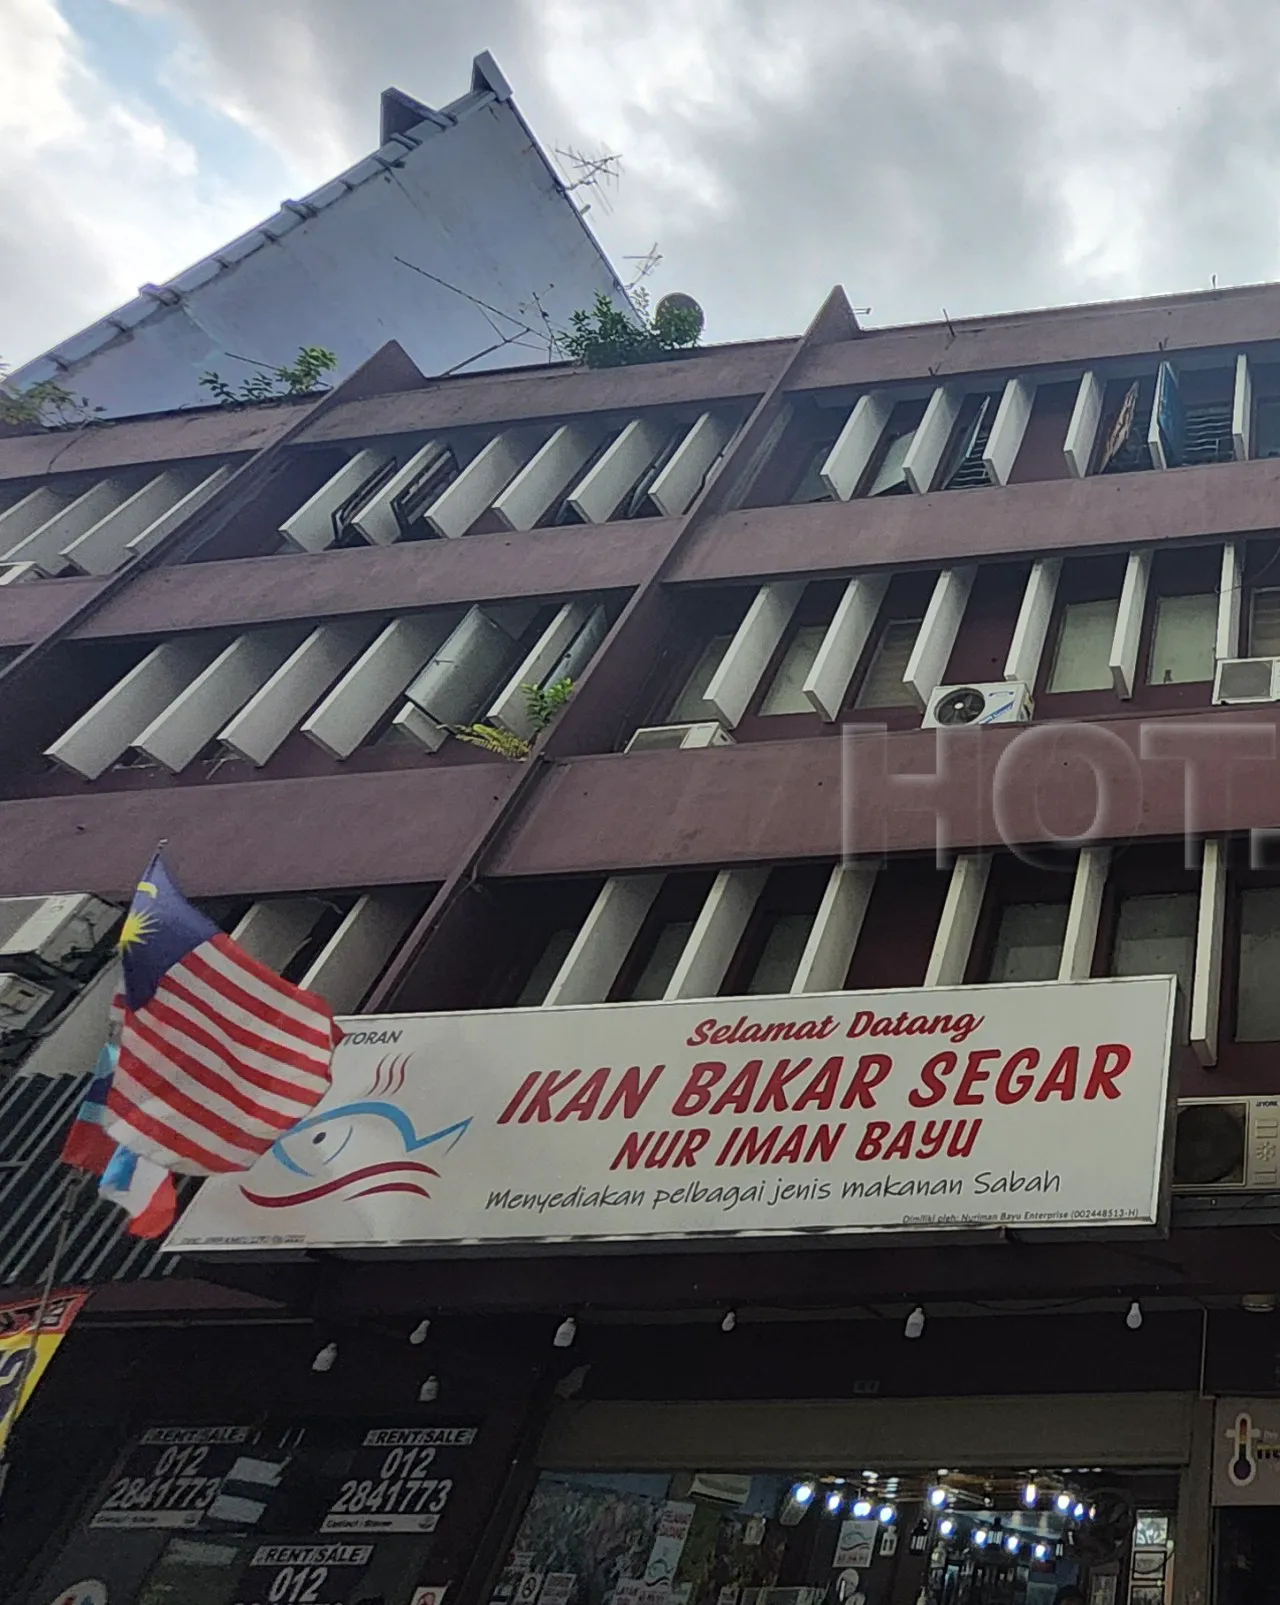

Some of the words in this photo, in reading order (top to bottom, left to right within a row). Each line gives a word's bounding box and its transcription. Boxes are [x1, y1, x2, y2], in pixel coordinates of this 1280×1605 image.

[343, 1030, 403, 1046] TORAN
[687, 1014, 840, 1046] Selamat
[845, 1010, 986, 1043] Datang
[497, 1064, 667, 1125] IKAN
[671, 1052, 893, 1118] BAKAR
[907, 1043, 1133, 1108] SEGAR
[609, 1129, 714, 1172] NUR
[714, 1121, 846, 1167] IMAN
[853, 1117, 983, 1161] BAYU
[485, 1185, 645, 1213] Menyediakan
[651, 1178, 766, 1210] pelbagai
[766, 1177, 835, 1207] jenis
[840, 1174, 963, 1200] makanan
[972, 1170, 1061, 1195] Sabah
[1024, 1207, 1069, 1219] Enterprise
[155, 1446, 208, 1476] 012
[380, 1447, 436, 1478] 012
[331, 1479, 453, 1513] 2841773
[269, 1567, 328, 1602] 012
